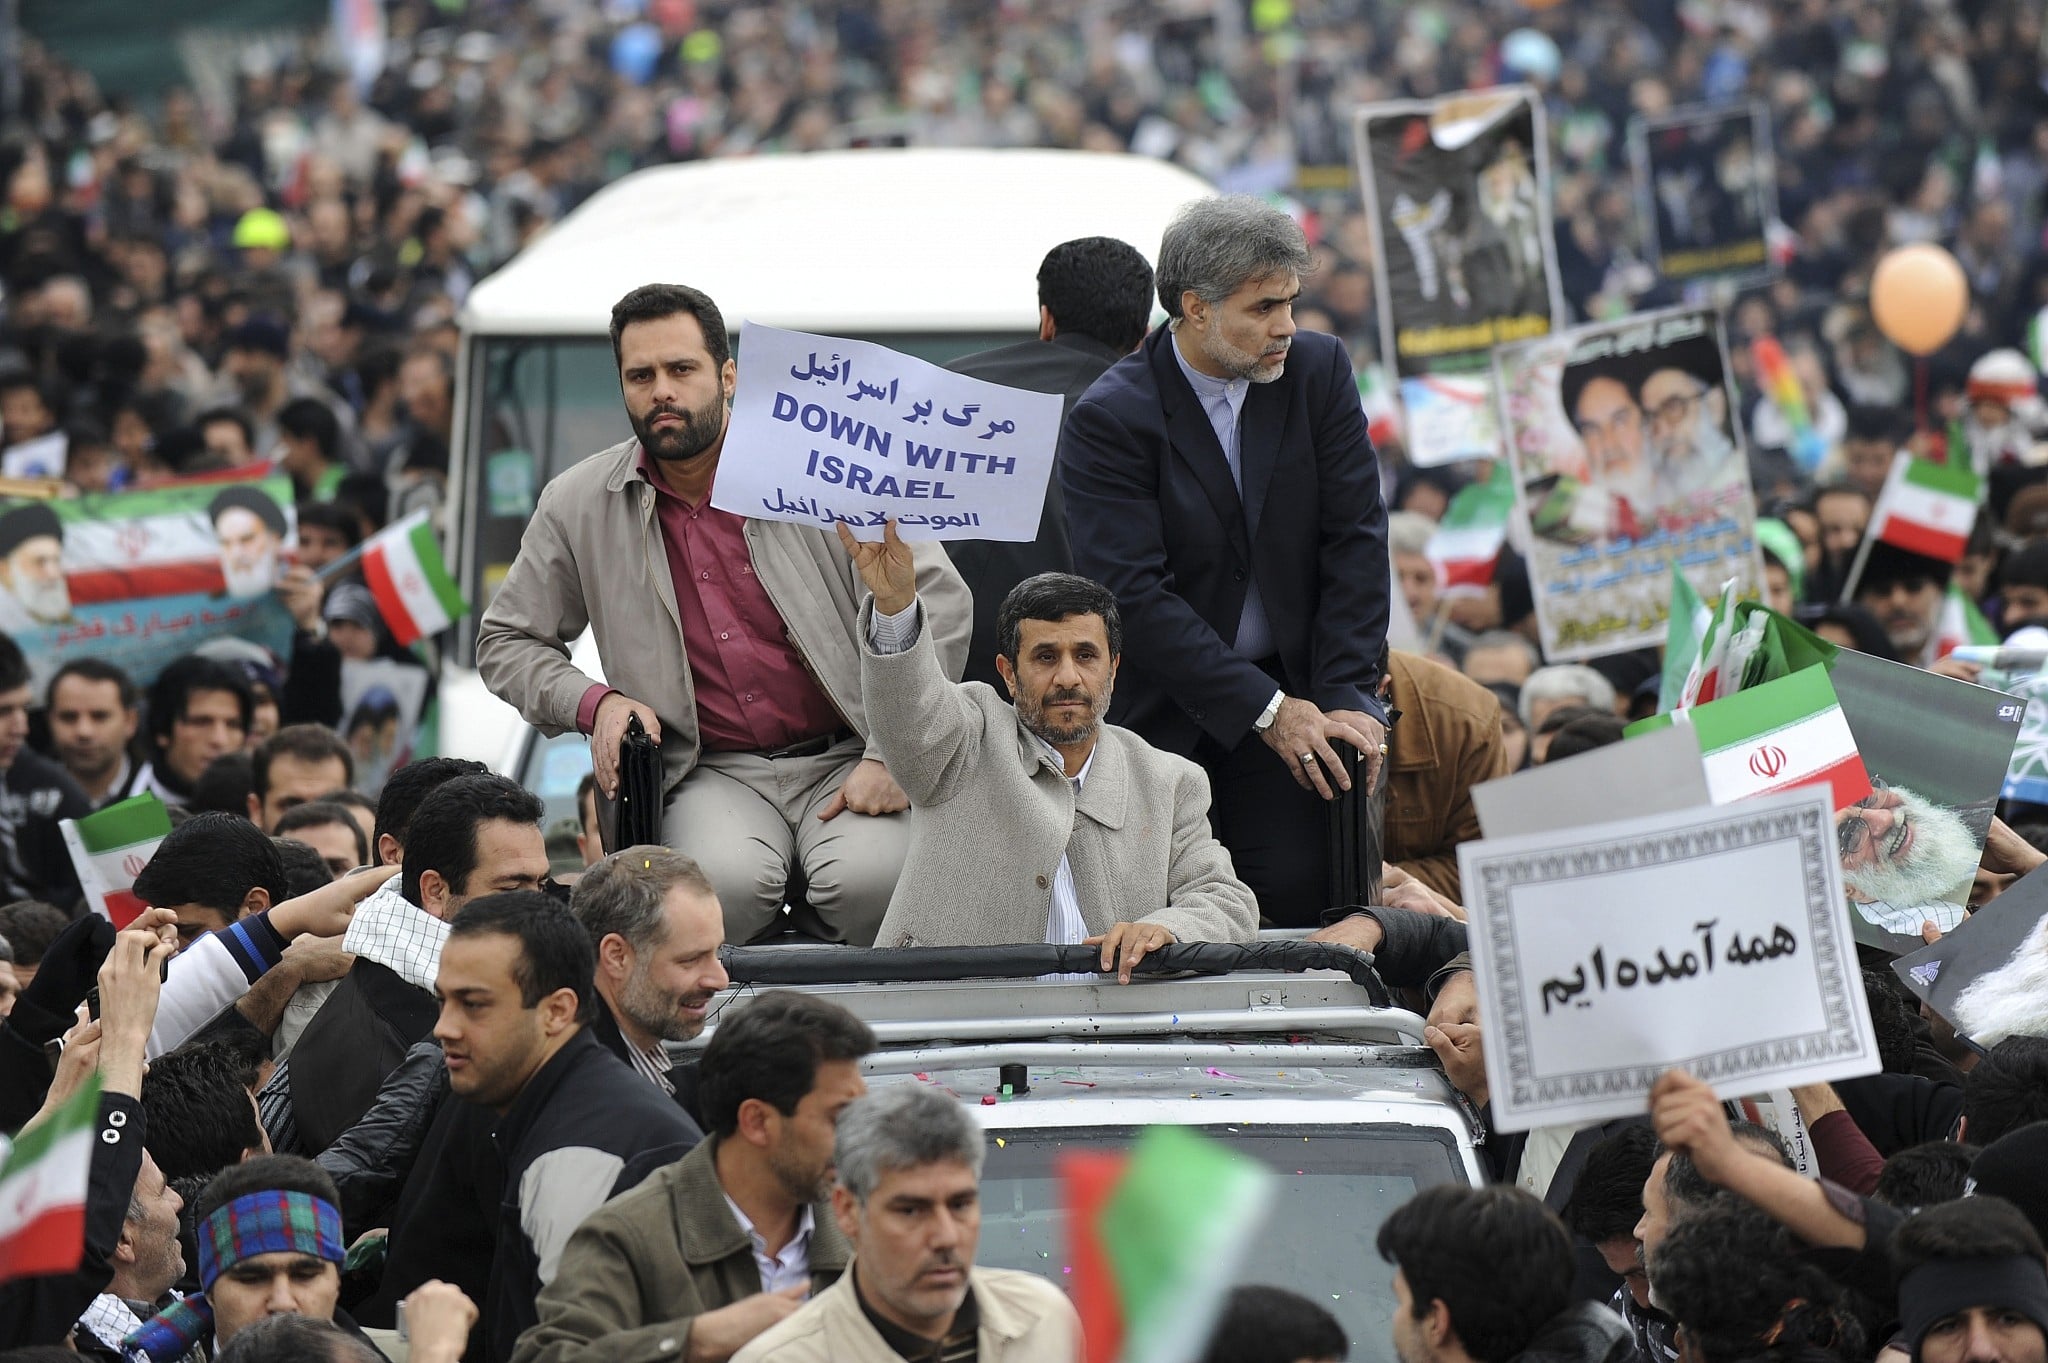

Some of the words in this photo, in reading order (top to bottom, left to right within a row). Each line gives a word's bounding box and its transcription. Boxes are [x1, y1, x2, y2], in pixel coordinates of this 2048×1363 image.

[789, 352, 899, 405] اسرائیل
[771, 391, 892, 458] DOWN
[905, 439, 1017, 475] WITH
[901, 398, 934, 427] بر
[942, 402, 1016, 440] مرگ
[805, 449, 957, 500] ISRAEL
[897, 511, 981, 532] الموت
[1726, 923, 1797, 967] همه
